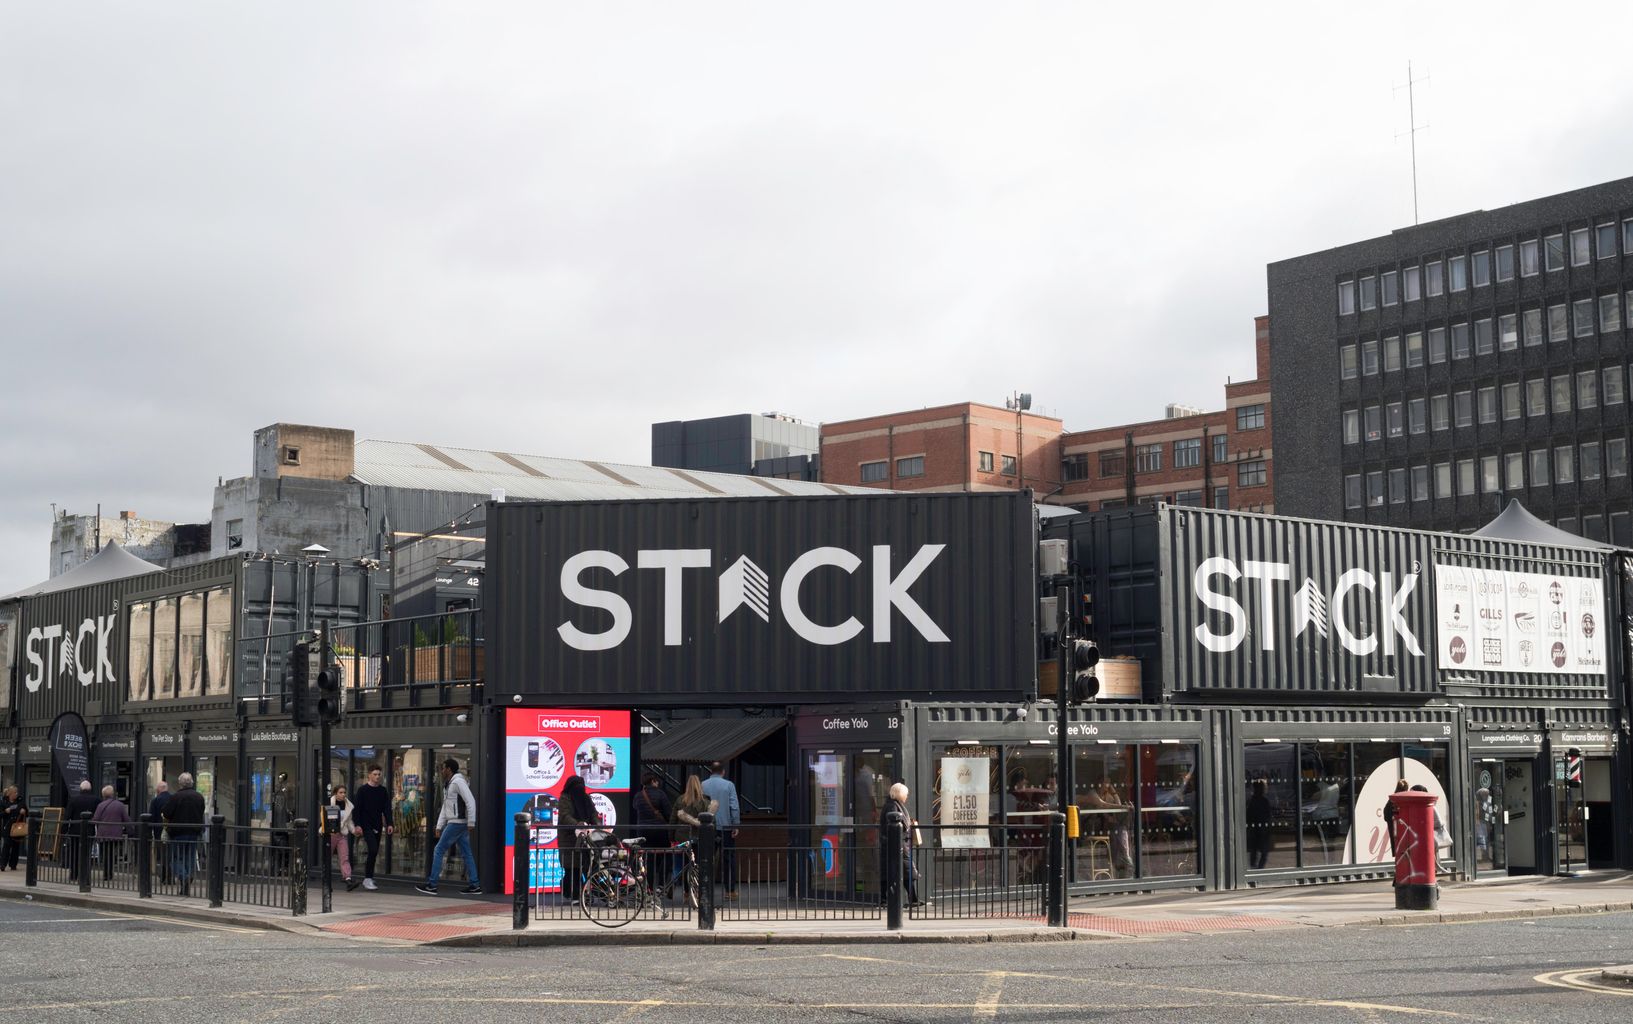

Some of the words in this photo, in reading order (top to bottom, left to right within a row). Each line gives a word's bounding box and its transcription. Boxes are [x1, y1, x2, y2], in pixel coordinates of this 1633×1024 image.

[467, 578, 479, 586] 42
[1480, 608, 1502, 619] GILLS
[542, 719, 568, 728] Office
[569, 719, 597, 729] Outlet
[823, 719, 850, 729] Coffee
[851, 718, 868, 728] Yolo
[888, 718, 898, 728] 18
[1048, 724, 1078, 735] Coee
[1080, 724, 1098, 735] Yolo
[1443, 726, 1450, 735] 19
[272, 732, 291, 742] Boutique
[1506, 734, 1522, 743] Clothing
[1534, 734, 1542, 743] 20
[1587, 733, 1608, 741] Barbers
[953, 795, 977, 809] £1.50
[953, 810, 977, 820] COFFEES
